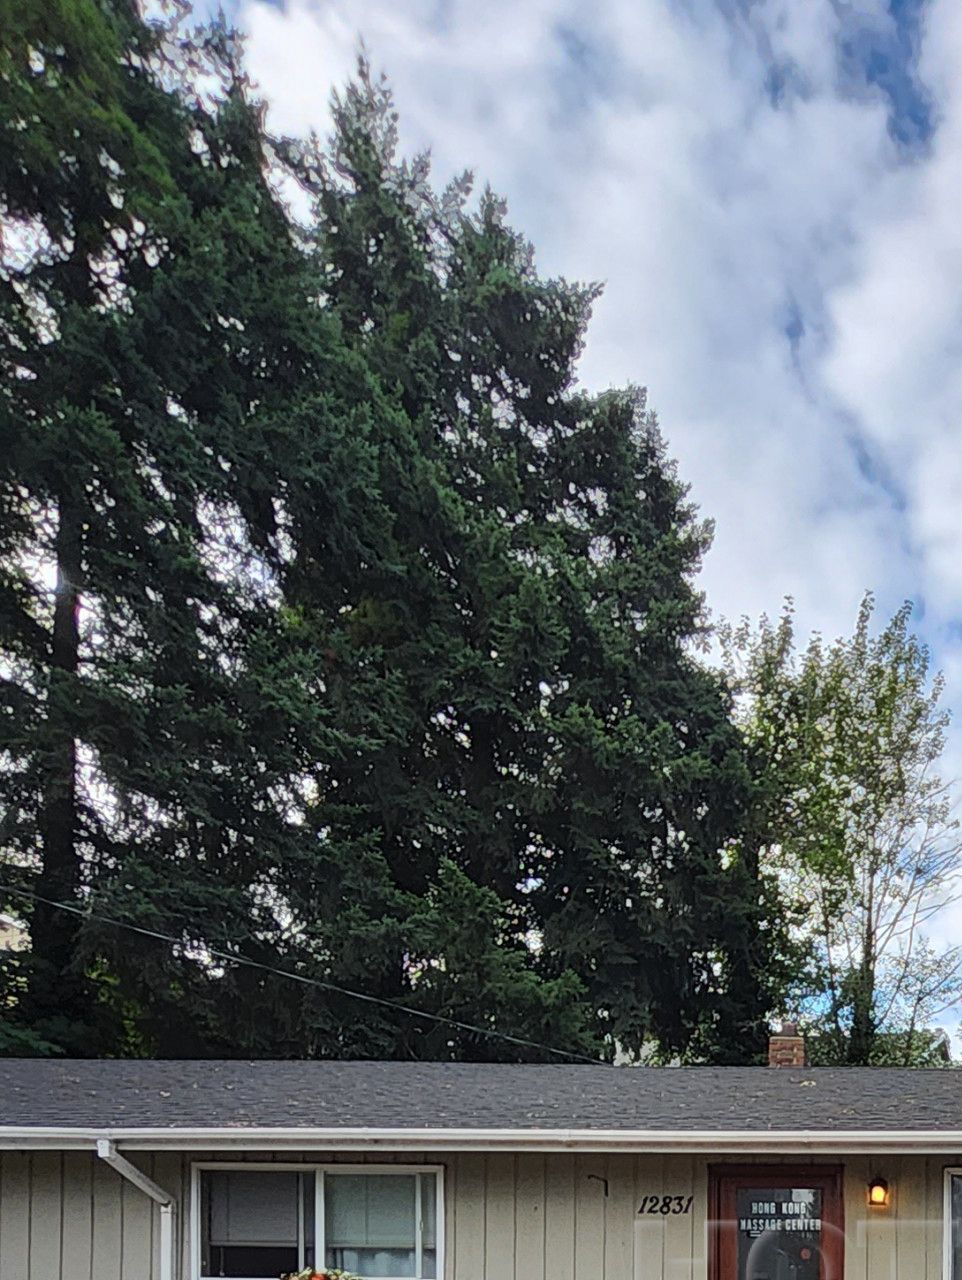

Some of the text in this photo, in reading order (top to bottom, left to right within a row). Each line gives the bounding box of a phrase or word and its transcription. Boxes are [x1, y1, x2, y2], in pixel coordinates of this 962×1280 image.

[638, 1195, 694, 1215] 12831
[751, 1202, 806, 1214] HONG KONG
[740, 1219, 821, 1230] MASSAGE CENTER
